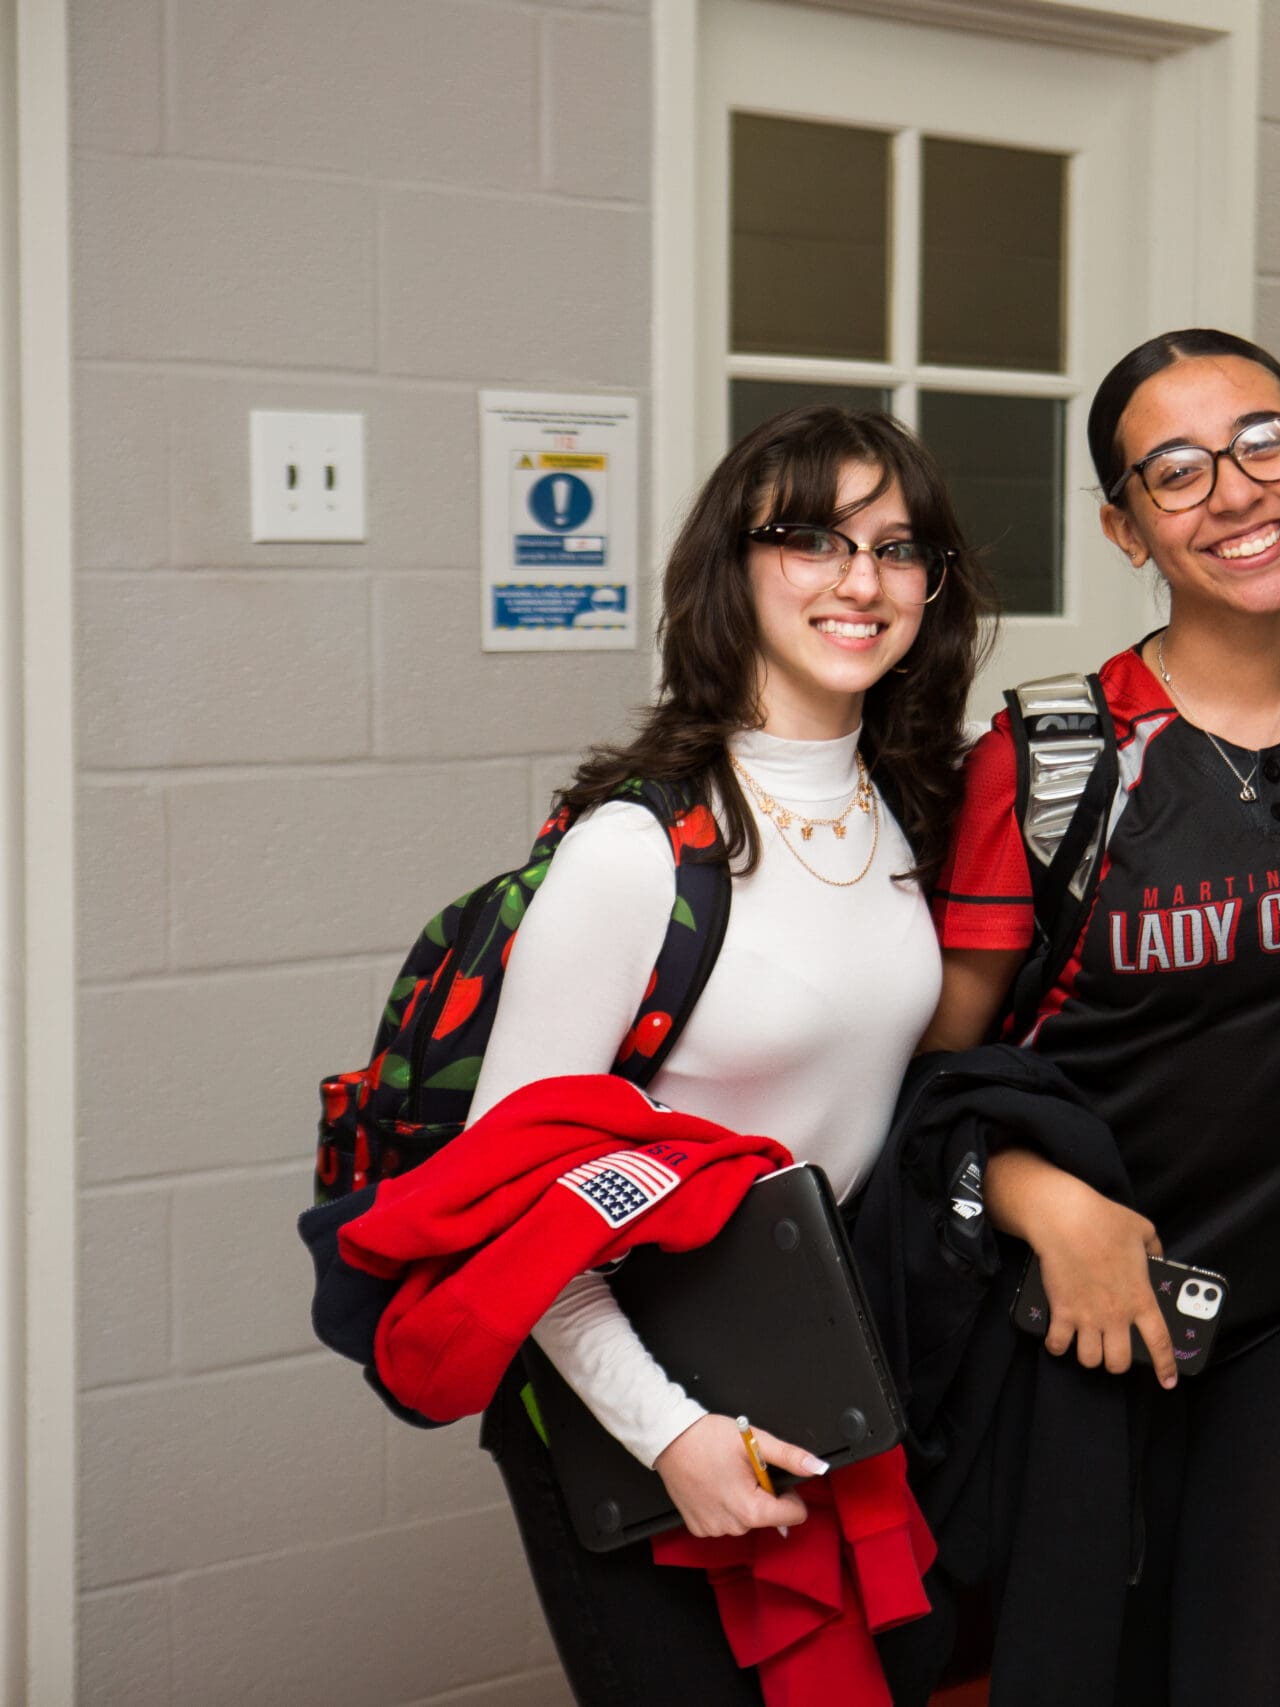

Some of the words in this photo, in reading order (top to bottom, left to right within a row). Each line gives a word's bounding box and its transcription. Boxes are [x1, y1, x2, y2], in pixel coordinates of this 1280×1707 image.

[1142, 870, 1280, 909] MARTIN
[1109, 898, 1242, 974] LADY
[647, 1144, 689, 1167] US
